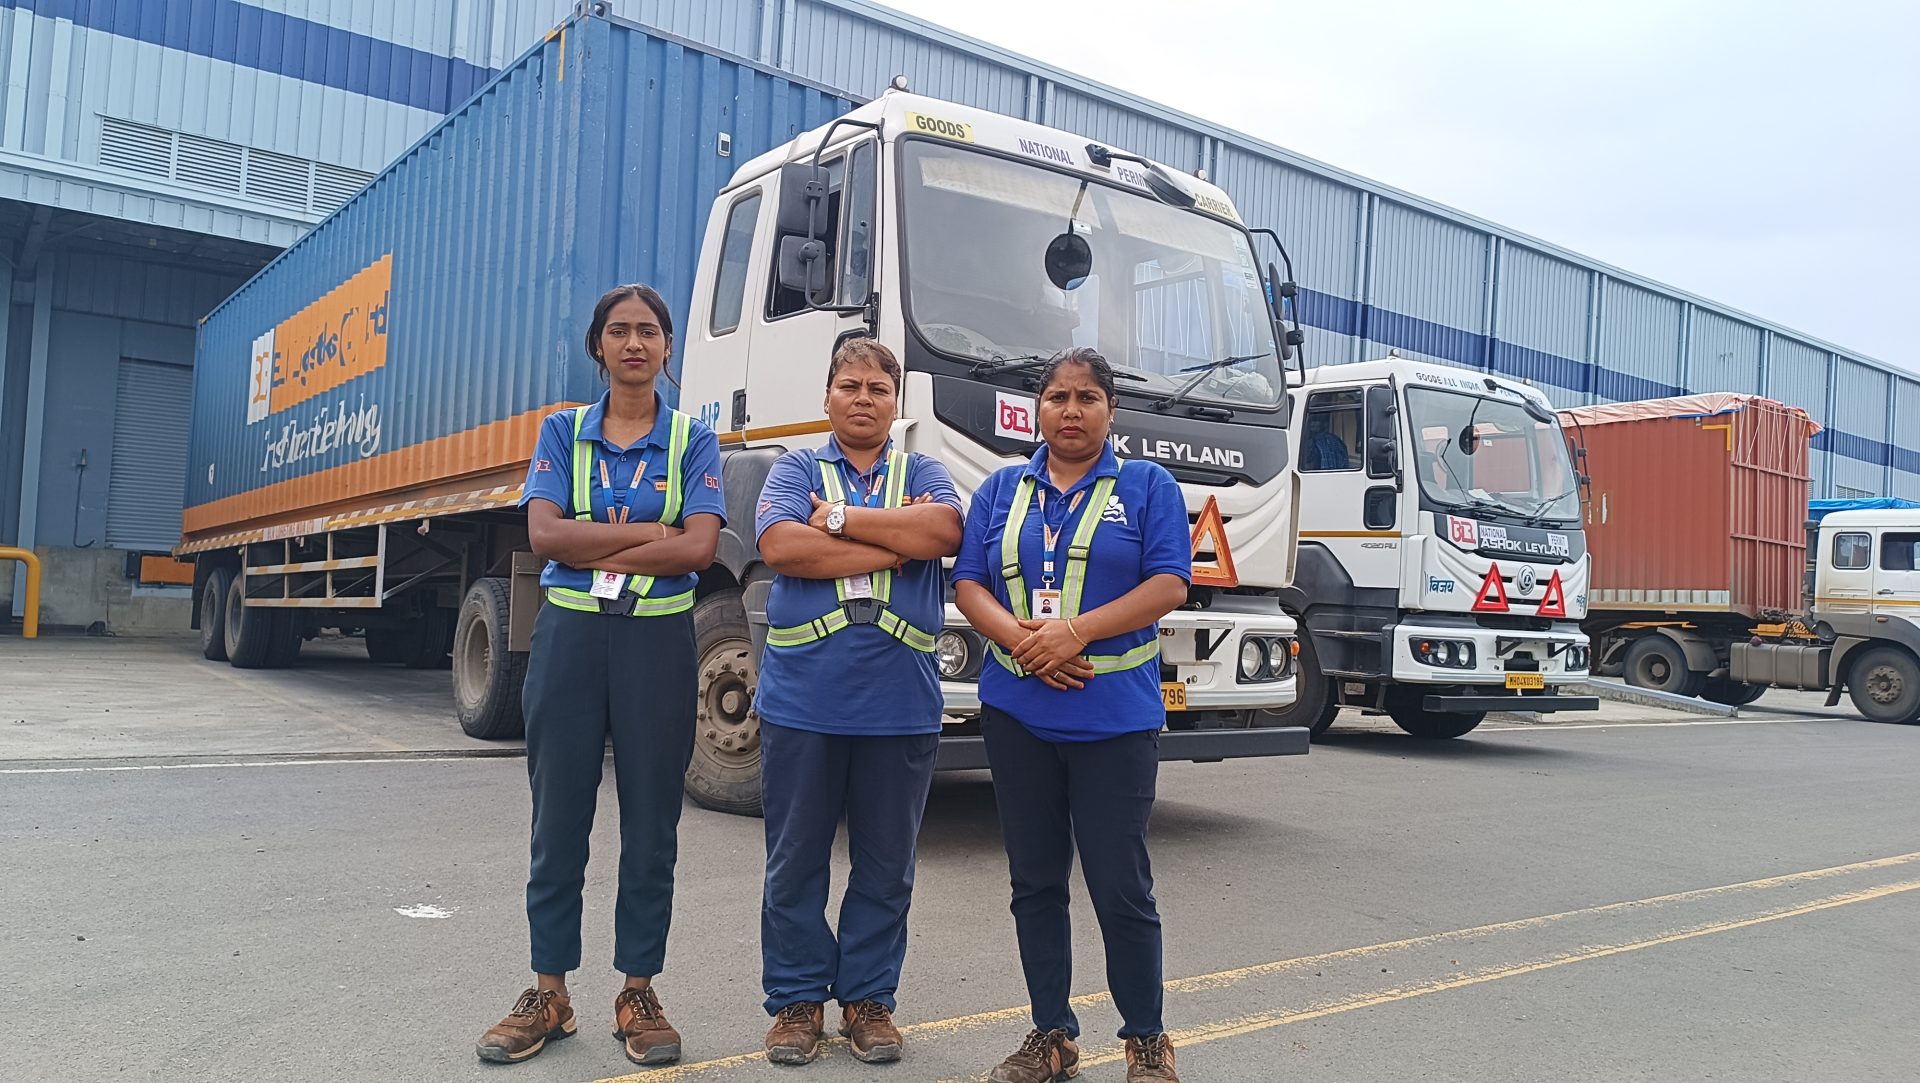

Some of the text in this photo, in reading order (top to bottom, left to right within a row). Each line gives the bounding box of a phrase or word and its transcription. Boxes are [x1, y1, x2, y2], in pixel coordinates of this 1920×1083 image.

[915, 115, 965, 138] GOODS
[1018, 138, 1075, 166] NATIONAL
[1117, 166, 1147, 188] PERM
[1142, 438, 1244, 469] LEYLAND
[1480, 526, 1506, 539] NATIONAL
[1480, 538, 1570, 557] ASHOK LEYLAND
[1160, 688, 1184, 705] 796
